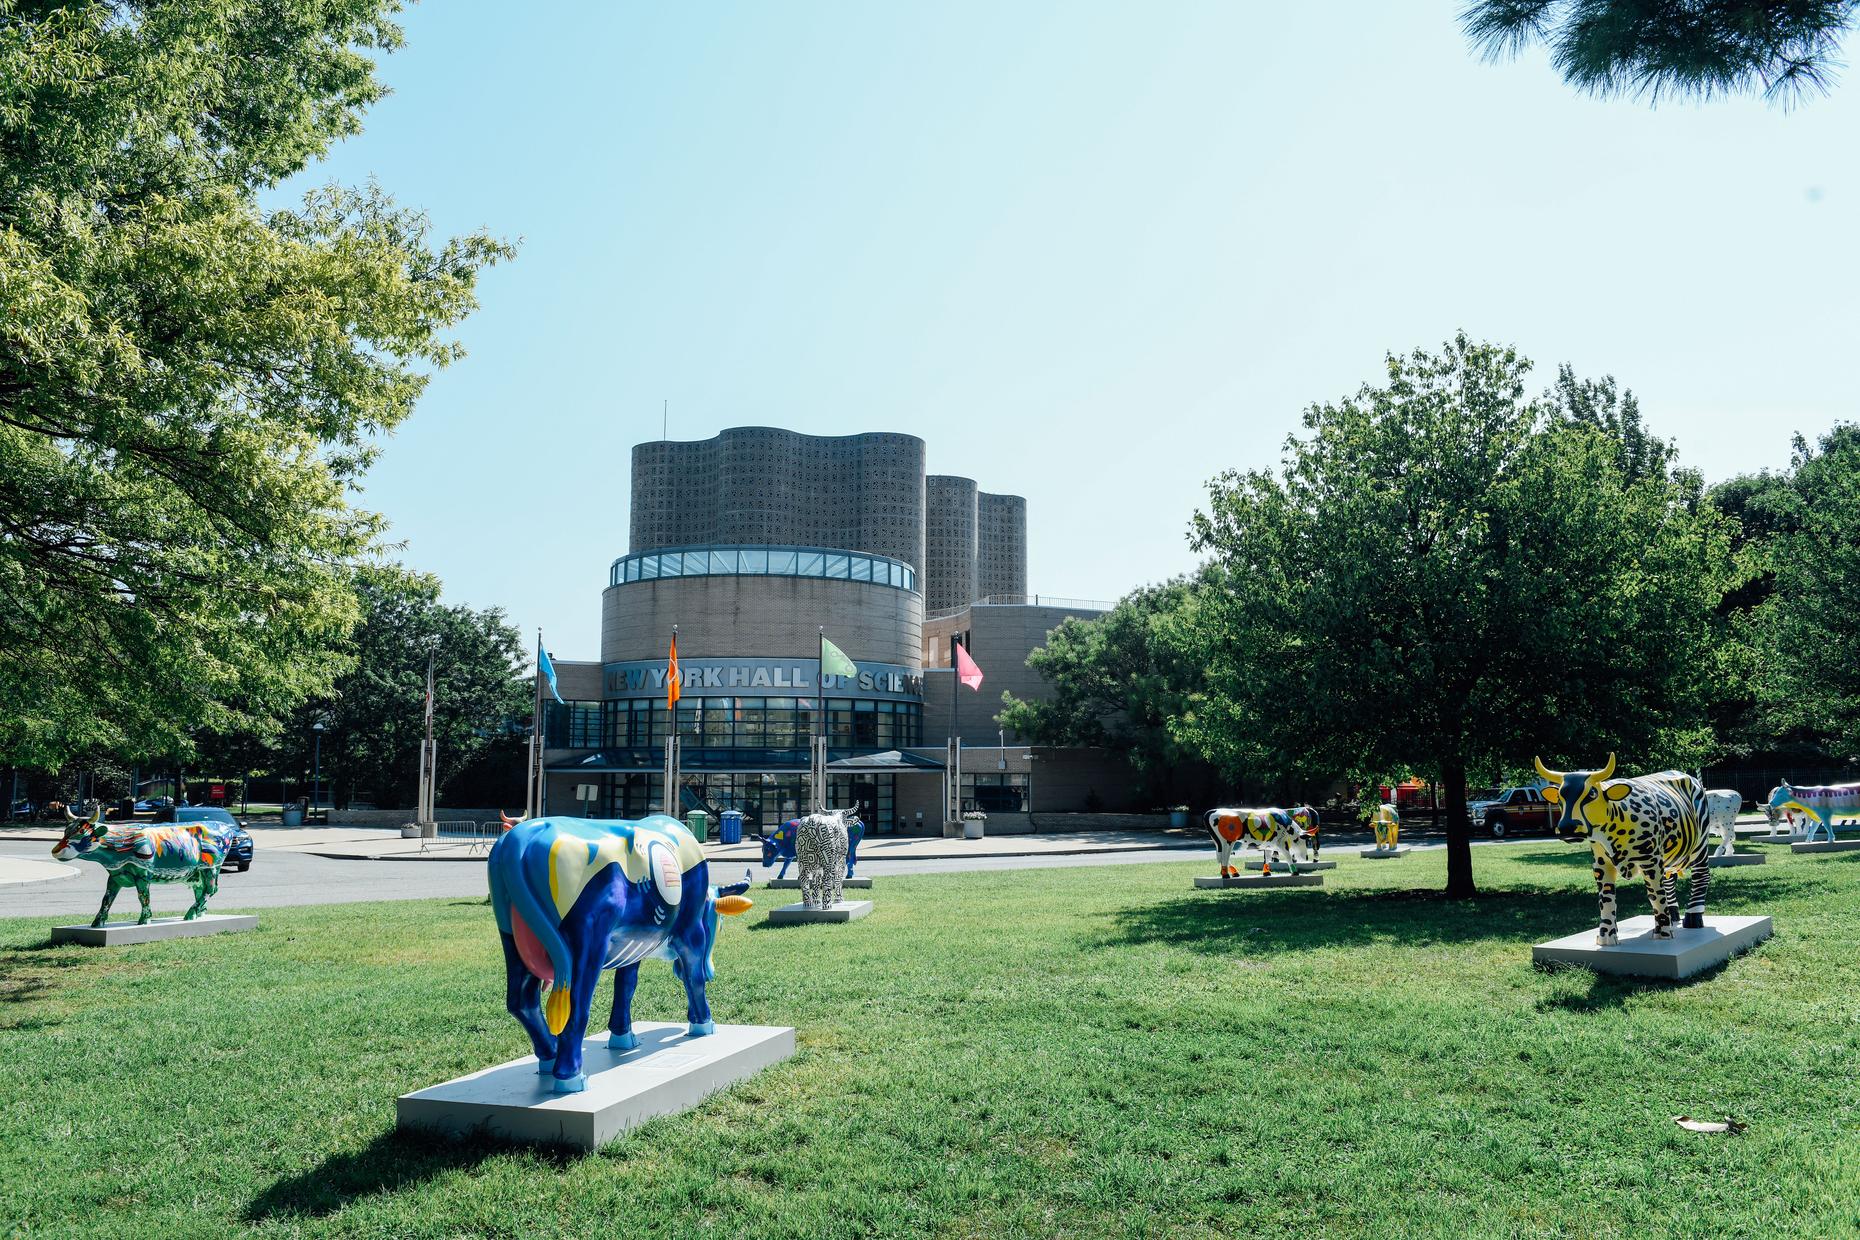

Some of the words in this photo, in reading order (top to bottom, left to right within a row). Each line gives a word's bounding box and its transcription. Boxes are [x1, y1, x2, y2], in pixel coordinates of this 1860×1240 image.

[607, 669, 647, 691] NEW
[728, 666, 810, 688] HALL
[859, 671, 922, 696] SCIEN
